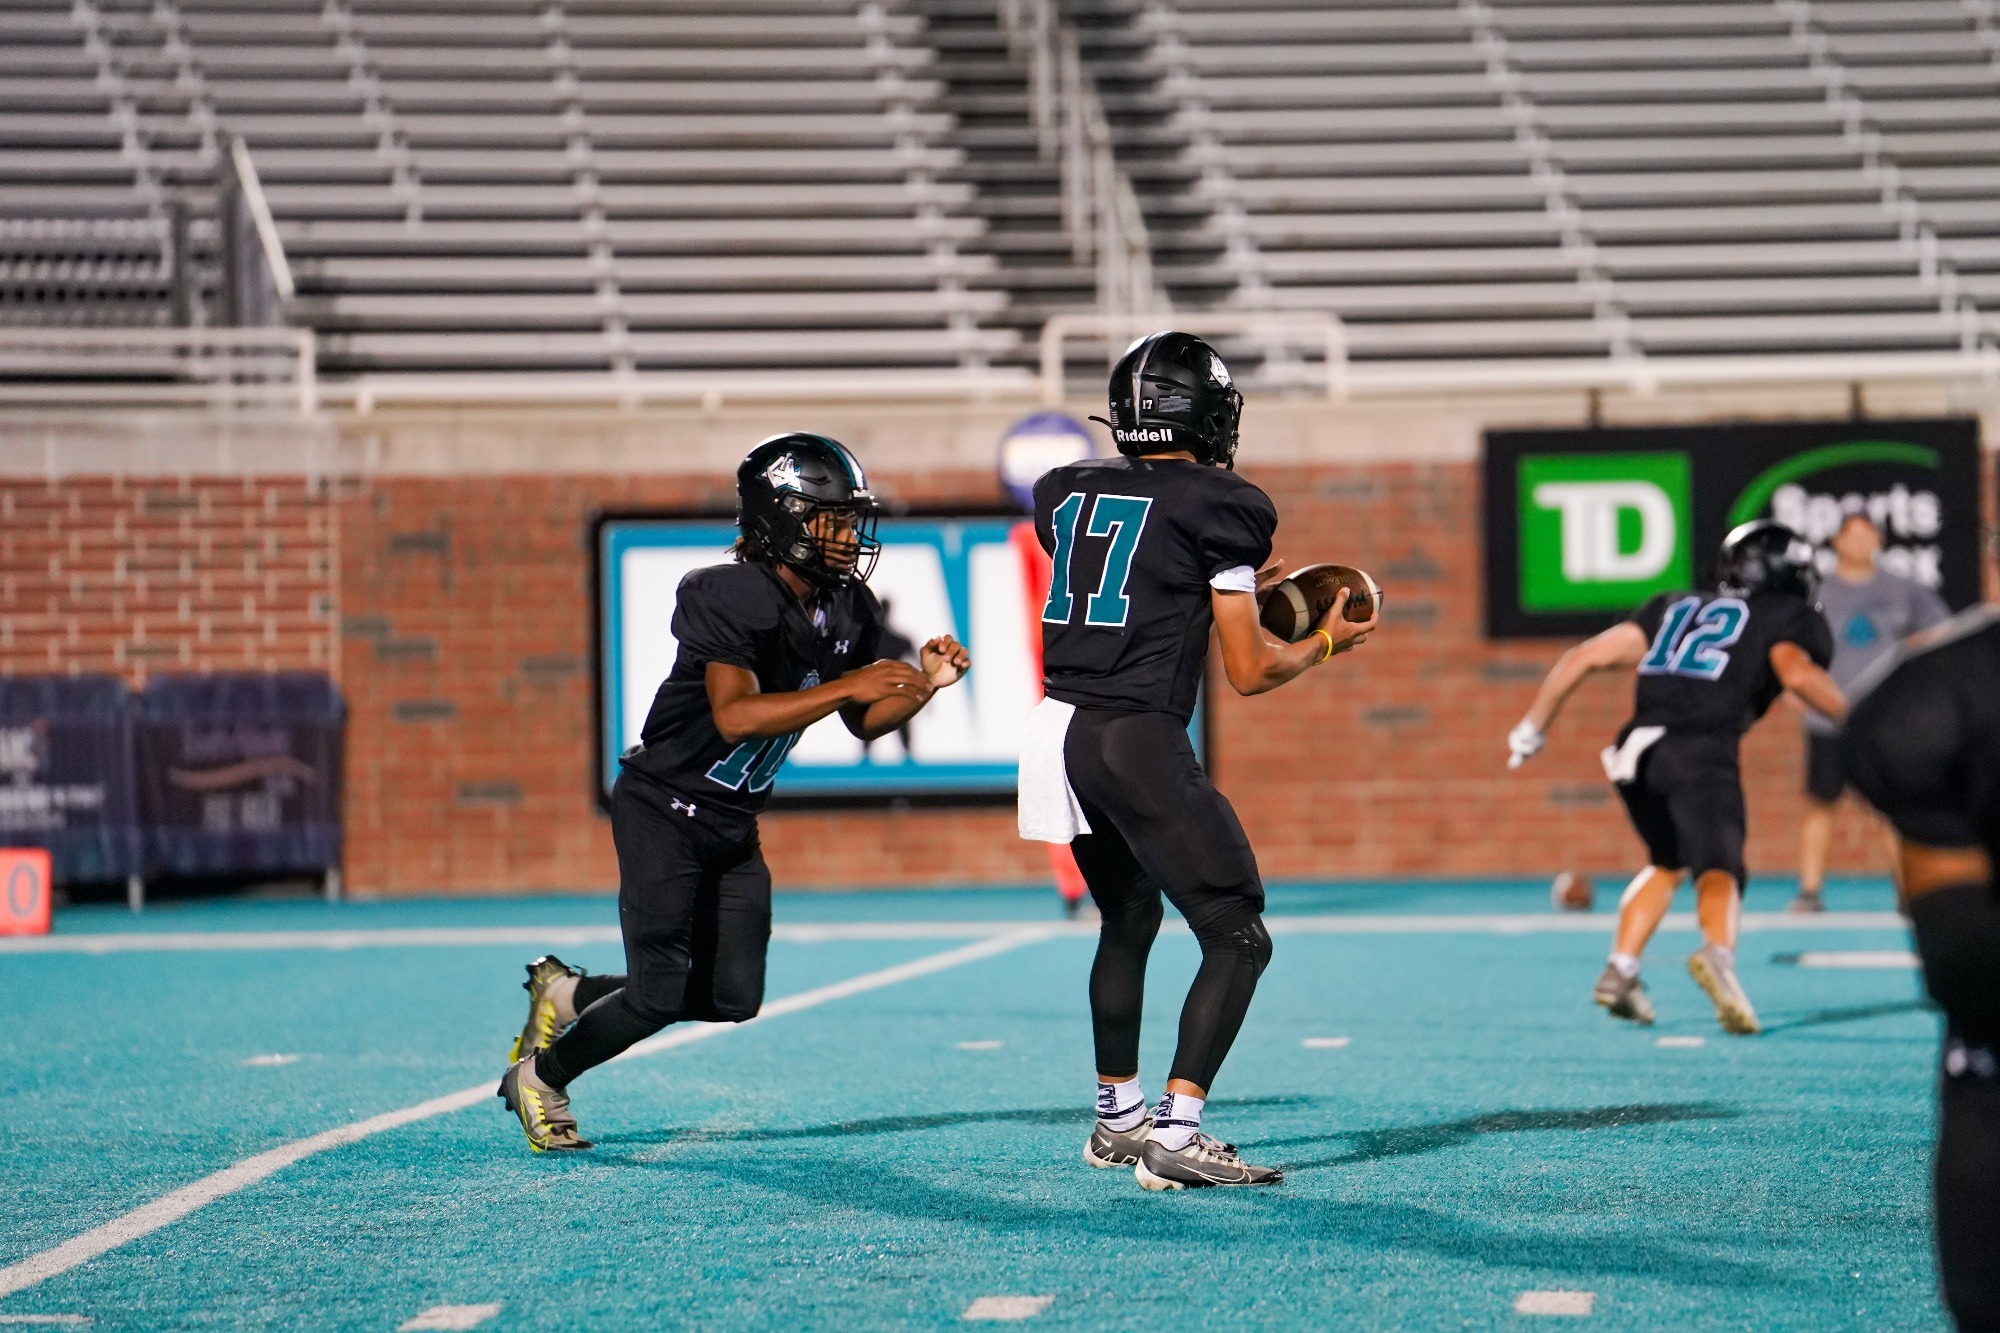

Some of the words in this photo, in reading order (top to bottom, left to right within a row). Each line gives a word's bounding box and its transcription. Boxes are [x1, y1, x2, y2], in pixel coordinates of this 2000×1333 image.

[1116, 428, 1173, 441] Riddell
[1142, 399, 1153, 410] 17
[1041, 491, 1154, 628] 17
[1533, 480, 1676, 583] TD
[1637, 595, 1751, 682] 12
